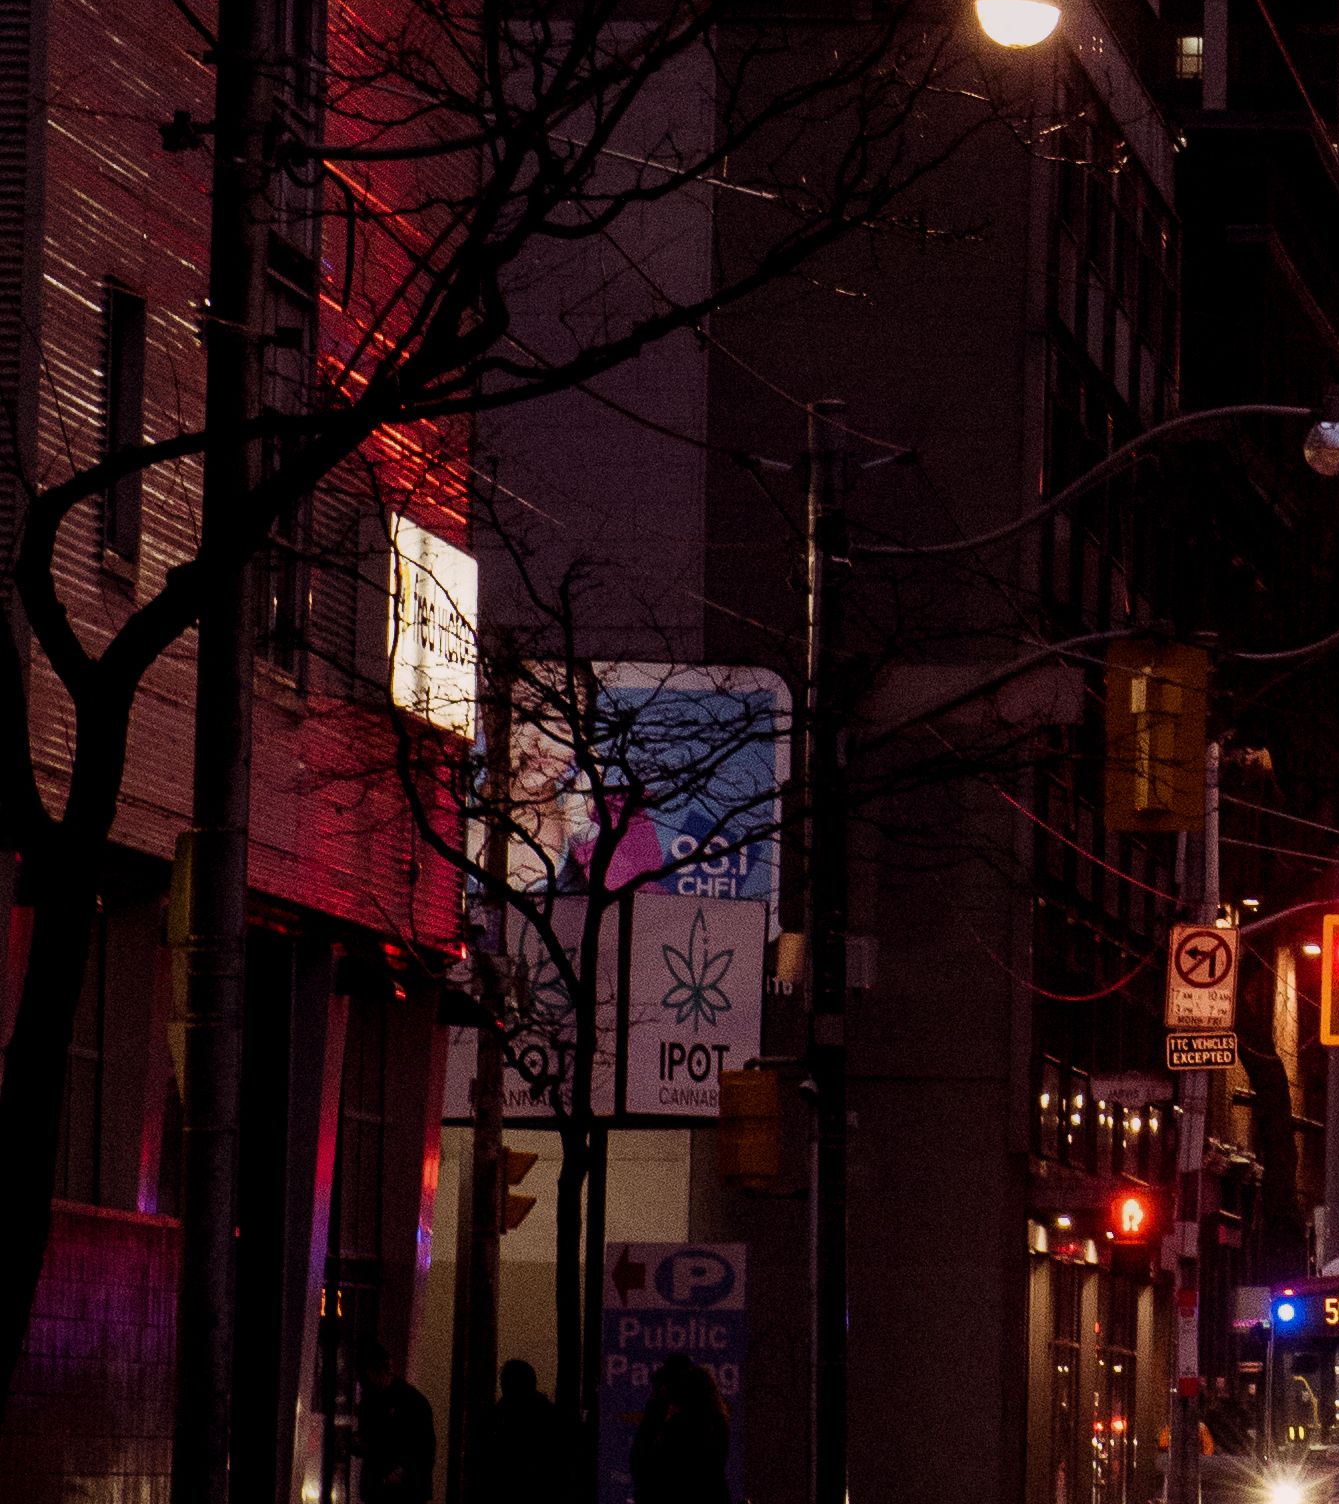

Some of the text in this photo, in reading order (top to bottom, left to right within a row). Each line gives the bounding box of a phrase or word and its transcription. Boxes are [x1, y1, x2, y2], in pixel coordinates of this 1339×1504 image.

[677, 877, 737, 897] CHFI
[1170, 1037, 1235, 1050] TTC VEHICLES
[659, 1042, 730, 1082] IPOT
[1173, 1051, 1233, 1064] EXCEPTED
[619, 1316, 728, 1349] Public
